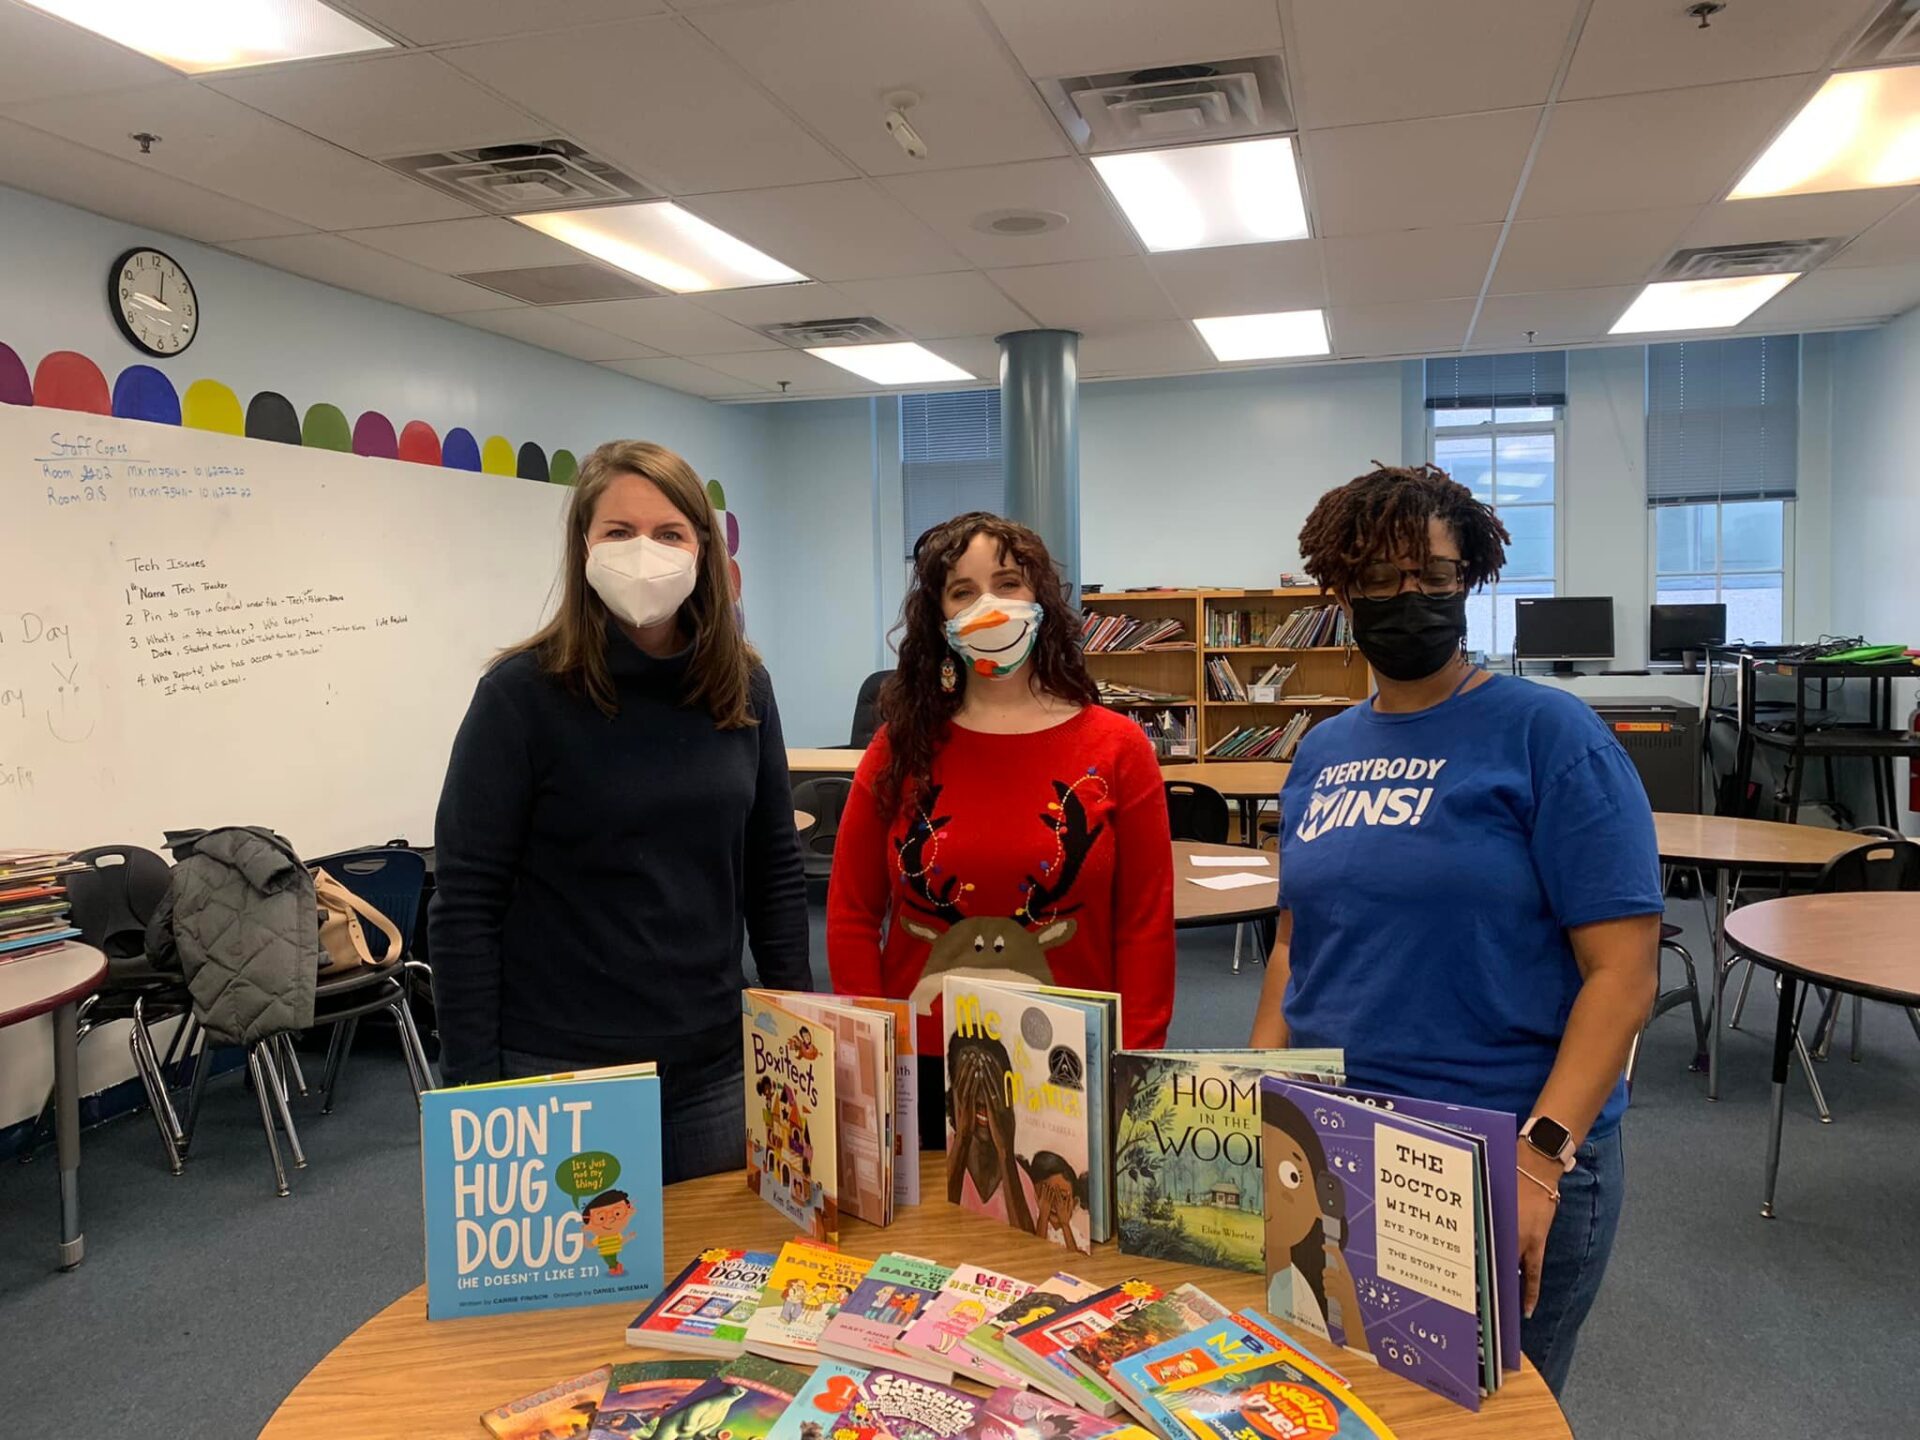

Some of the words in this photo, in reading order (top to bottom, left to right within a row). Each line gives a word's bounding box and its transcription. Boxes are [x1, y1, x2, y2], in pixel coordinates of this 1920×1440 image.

[136, 256, 143, 268] 11
[151, 255, 162, 268] 12
[123, 269, 133, 281] 10
[121, 288, 129, 300] 9
[181, 282, 188, 295] 2
[127, 310, 135, 324] 8
[186, 304, 193, 317] 3
[141, 327, 148, 341] 7
[171, 336, 179, 347] 5
[156, 338, 164, 350] 6
[50, 432, 92, 456] Staff
[95, 439, 128, 457] Copies
[43, 465, 74, 479] Room
[47, 486, 81, 506] Room
[126, 557, 160, 573] Tech
[166, 558, 207, 571] Issues
[172, 583, 196, 596] Tech
[142, 608, 162, 622] Pin
[168, 609, 179, 619] to
[184, 607, 202, 619] Top
[20, 612, 72, 660] Day
[146, 632, 175, 646] What's
[196, 627, 212, 638] the
[152, 673, 169, 684] Who
[211, 660, 225, 673] Who
[231, 658, 245, 668] has
[165, 683, 178, 697] If
[181, 684, 202, 694] they
[1314, 757, 1448, 789] EVERYBODY
[1296, 786, 1435, 843] WINS!
[954, 993, 1002, 1041] Me
[752, 1033, 819, 1108] Boxitects
[896, 1065, 911, 1077] ith
[1003, 1069, 1082, 1119] Mama
[1173, 1072, 1261, 1116] HOM
[450, 1096, 592, 1162] DON'T
[1200, 1113, 1215, 1125] IN
[1223, 1115, 1251, 1130] THE
[1146, 1119, 1264, 1170] WOO
[572, 1159, 588, 1172] It's
[588, 1158, 607, 1172] just
[1396, 1143, 1444, 1175] THE
[573, 1169, 588, 1180] not
[590, 1168, 604, 1180] my
[575, 1177, 604, 1190] thing!
[454, 1158, 549, 1218] HUG
[1380, 1168, 1463, 1209] DOCTOR
[1386, 1196, 1432, 1223] WITH
[1435, 1215, 1458, 1232] AN
[456, 1210, 585, 1276] DOUG
[1384, 1219, 1405, 1234] EYE
[1408, 1228, 1429, 1242] FOR
[1432, 1236, 1462, 1253] EYES
[1388, 1247, 1407, 1261] THE
[1410, 1255, 1442, 1274] STORY
[1444, 1268, 1458, 1280] OF
[457, 1277, 480, 1291] (HE
[484, 1272, 539, 1287] DOESN'T
[545, 1267, 575, 1282] LIKE
[579, 1265, 601, 1279] IT)
[818, 1272, 859, 1285] CLUB
[910, 1280, 940, 1291] CLU
[689, 1288, 709, 1296] Three
[711, 1290, 733, 1299] Books
[1206, 1331, 1254, 1364] NA
[1246, 1393, 1309, 1439] true!
[1267, 1381, 1336, 1433] weird
